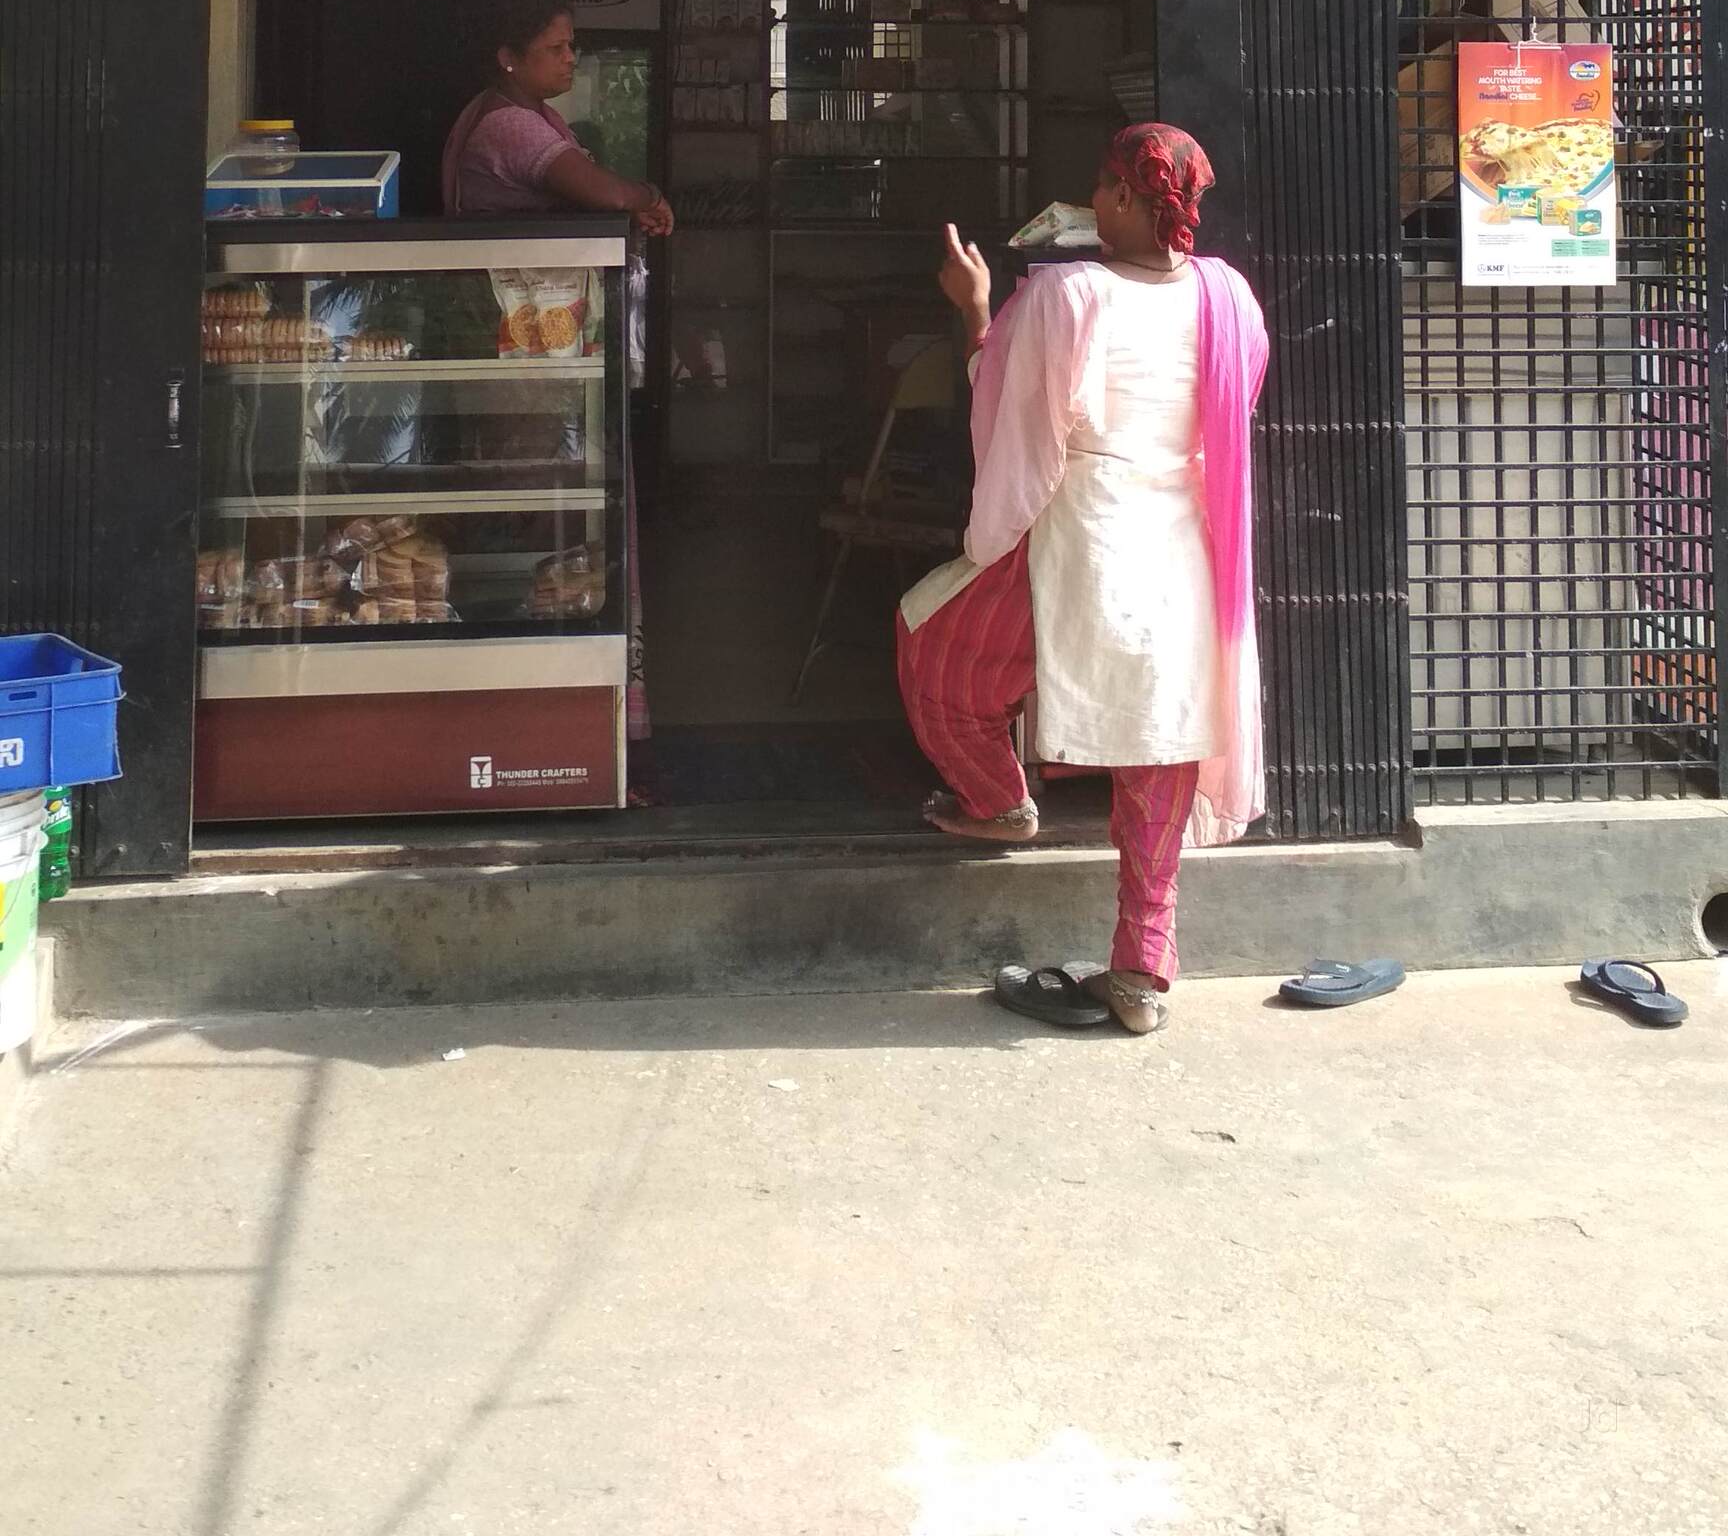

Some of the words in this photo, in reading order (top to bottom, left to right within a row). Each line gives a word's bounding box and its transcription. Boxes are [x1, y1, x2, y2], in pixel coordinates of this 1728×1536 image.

[1493, 69, 1508, 77] FOR
[1509, 68, 1527, 77] BEST
[1478, 76, 1506, 85] MOUTH
[1506, 76, 1542, 85] WATERING
[496, 769, 539, 779] THUNDER
[541, 768, 588, 778] CRAFTERS
